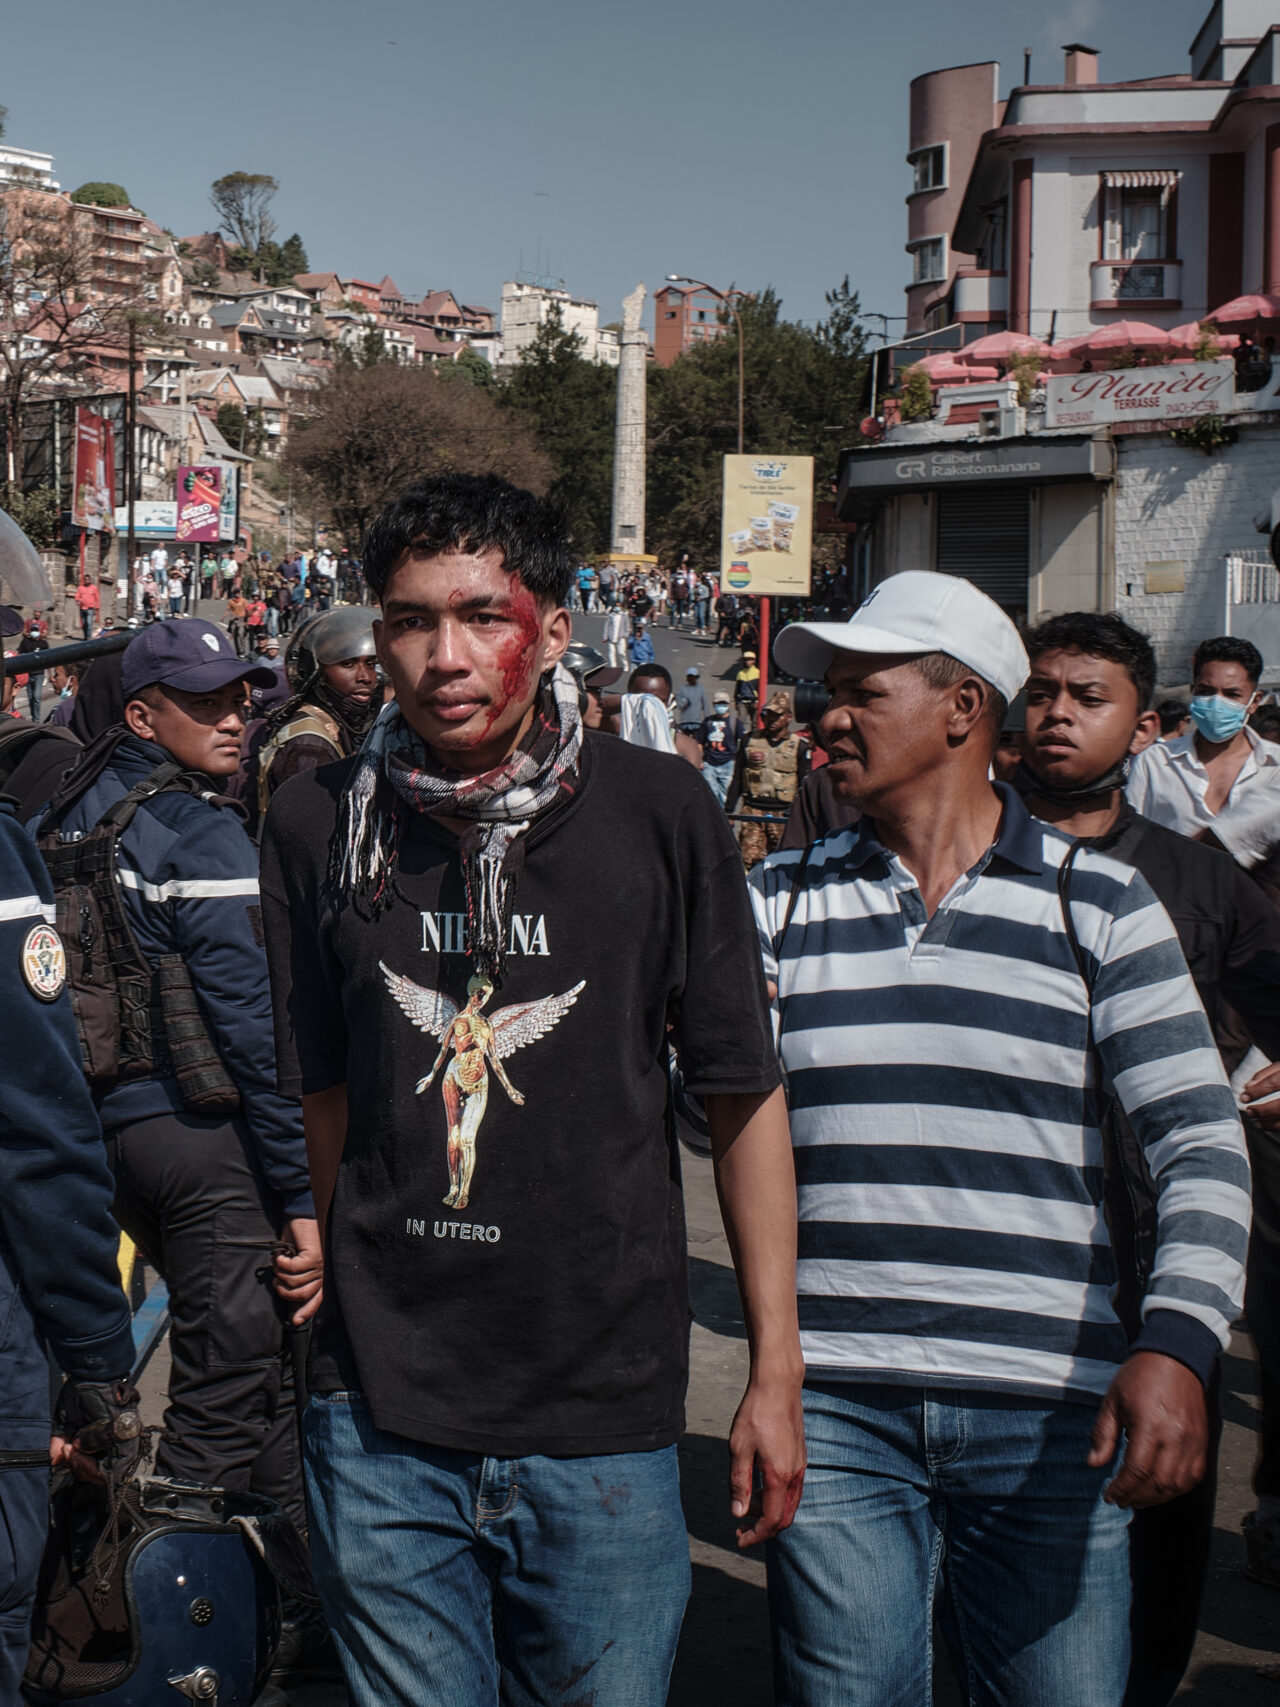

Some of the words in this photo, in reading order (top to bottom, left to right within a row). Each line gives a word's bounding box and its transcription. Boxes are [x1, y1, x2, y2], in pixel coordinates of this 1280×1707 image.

[1057, 370, 1221, 404] Planète
[1113, 395, 1161, 411] TERRASSE
[931, 452, 982, 465] Gilbert
[895, 460, 927, 479] GR
[931, 461, 1041, 477] Rakotomanana
[419, 911, 551, 956] NIRNA
[406, 1218, 425, 1236] IN
[433, 1221, 501, 1243] UTERO
